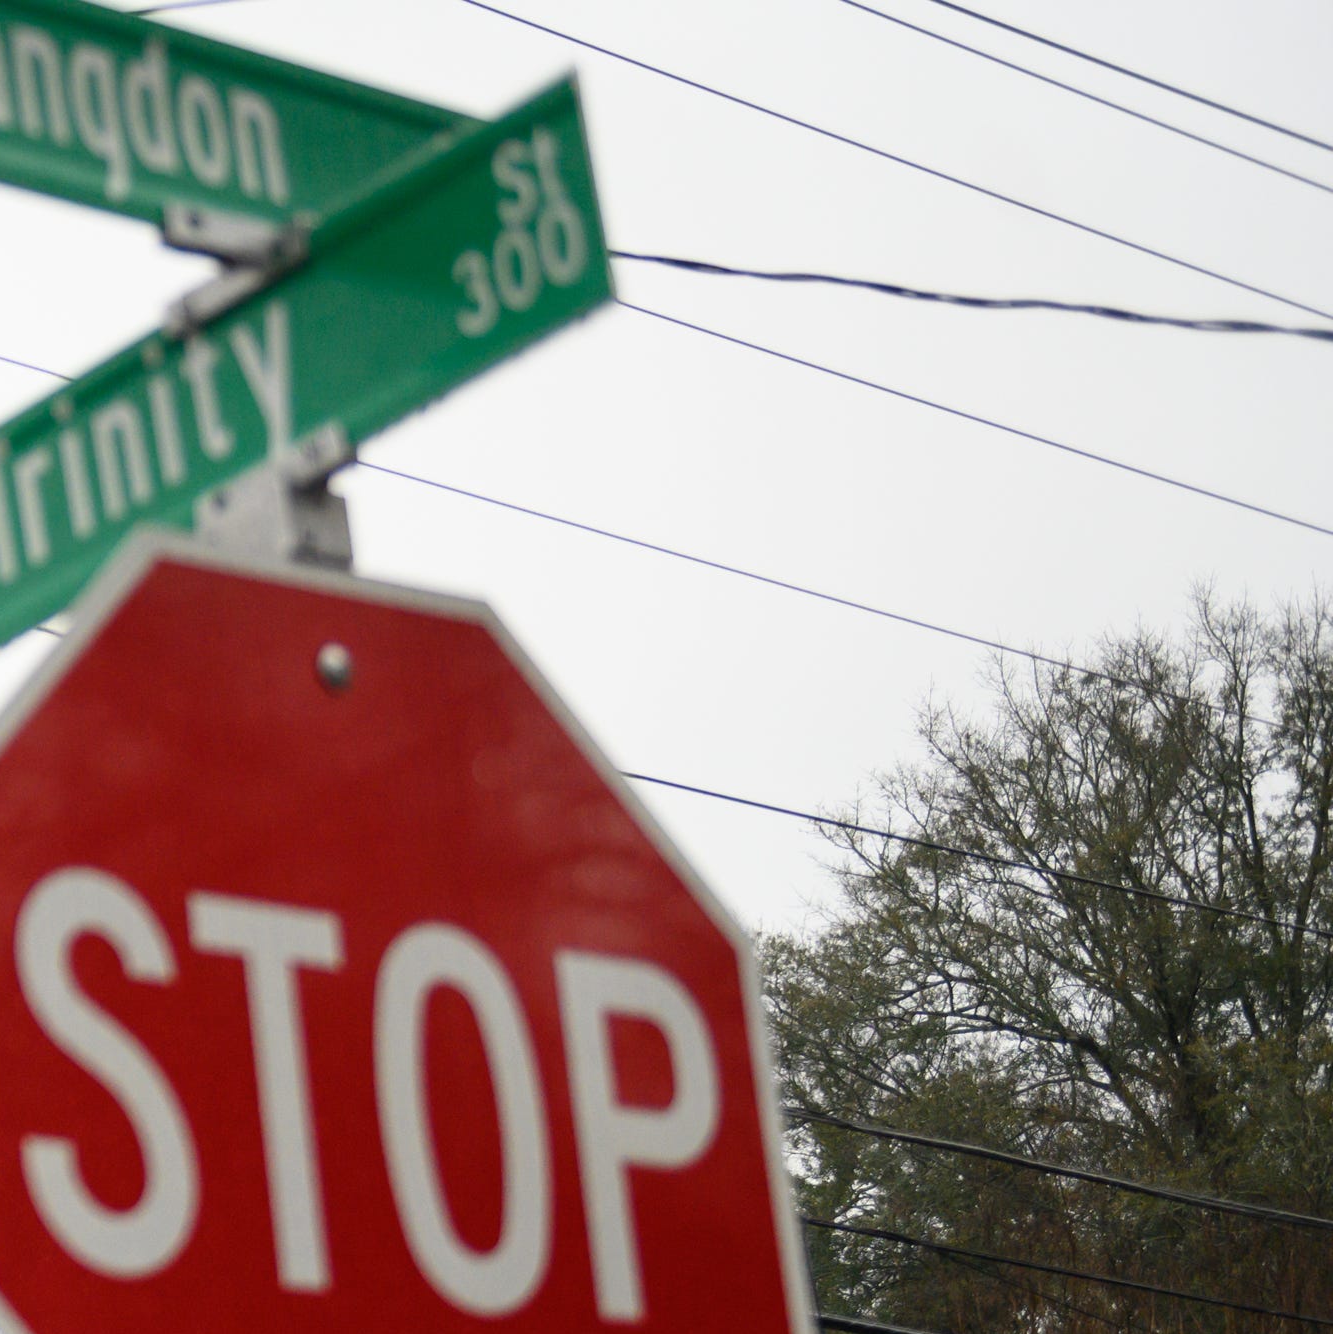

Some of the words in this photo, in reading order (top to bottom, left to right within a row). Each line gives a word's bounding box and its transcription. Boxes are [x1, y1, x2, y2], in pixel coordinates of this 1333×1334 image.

[491, 126, 564, 230] St
[452, 200, 588, 338] 300
[14, 864, 722, 1326] STOP
